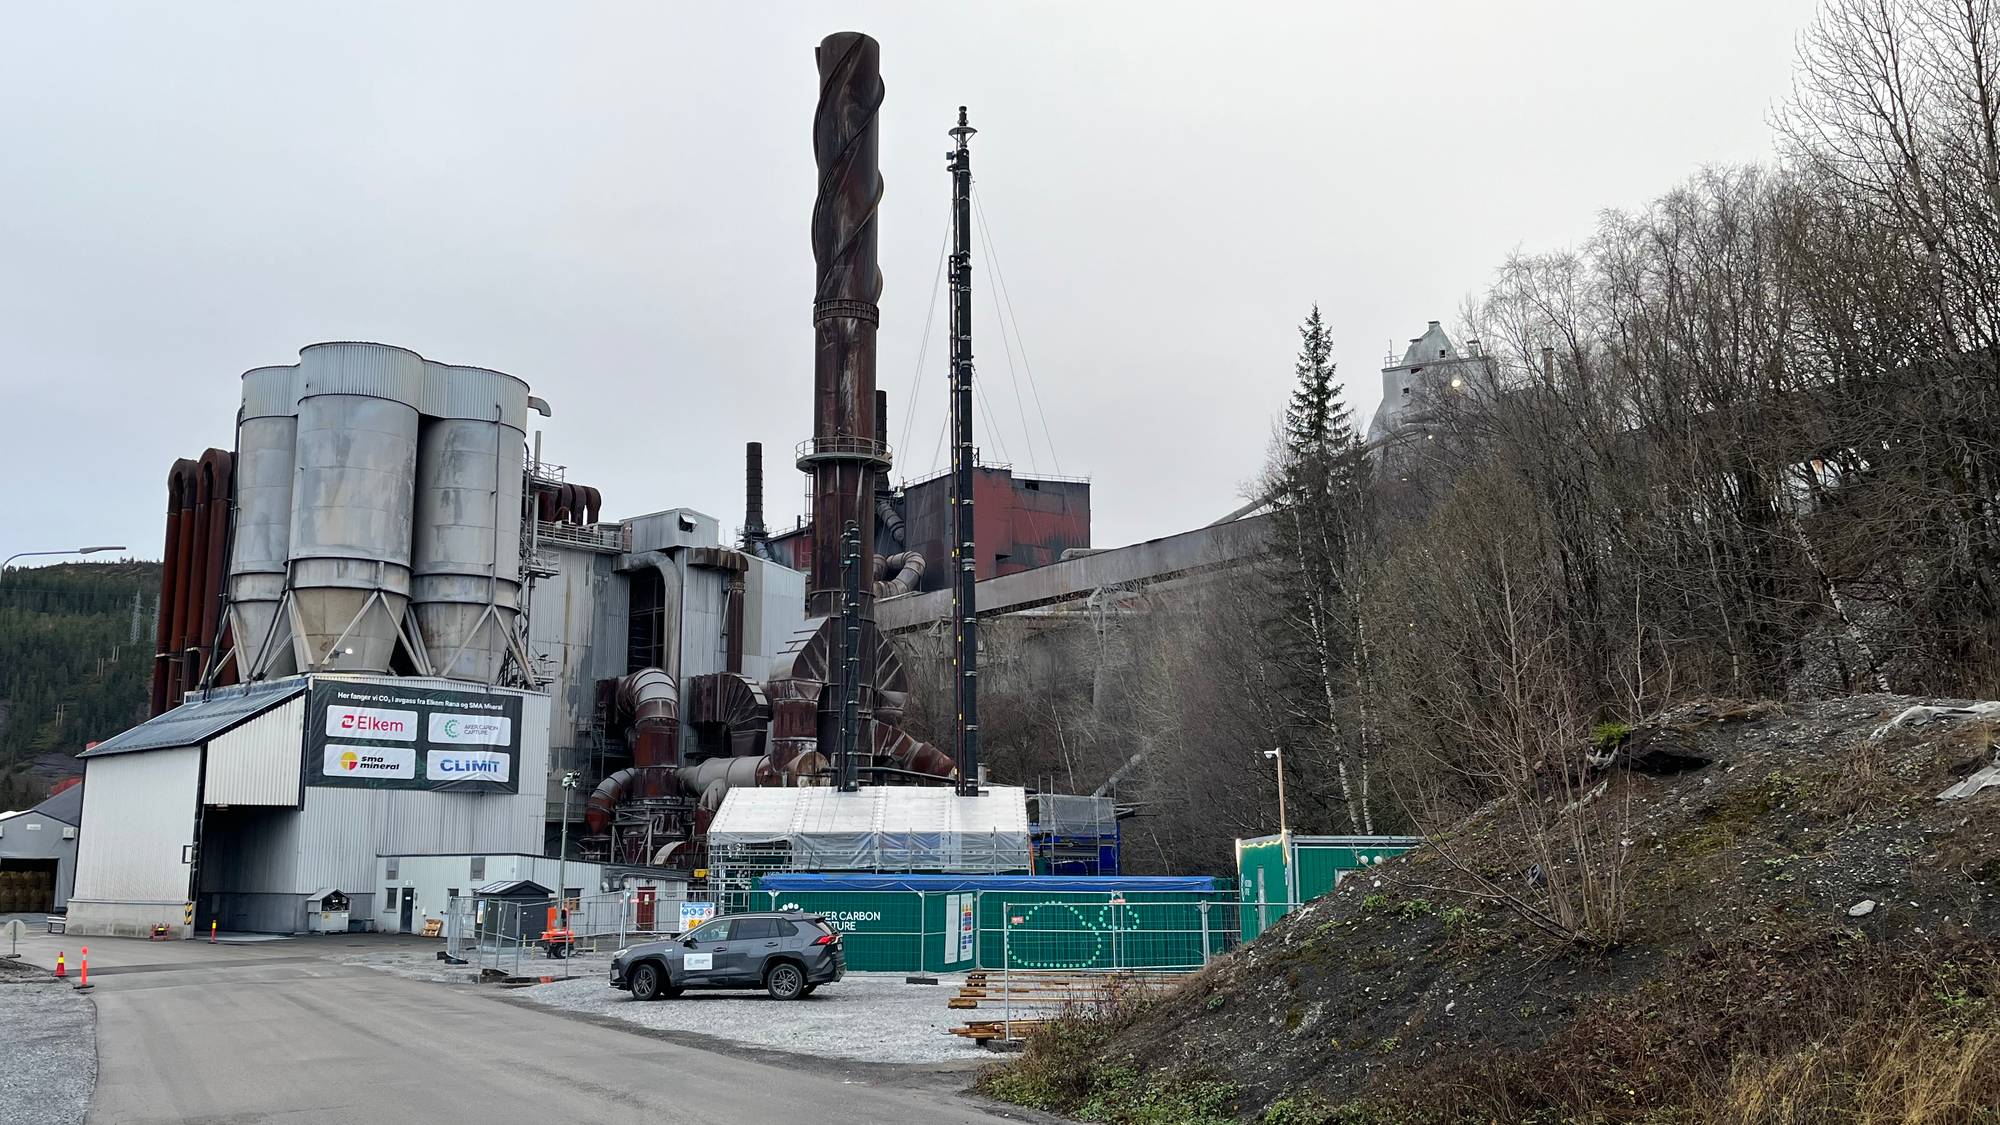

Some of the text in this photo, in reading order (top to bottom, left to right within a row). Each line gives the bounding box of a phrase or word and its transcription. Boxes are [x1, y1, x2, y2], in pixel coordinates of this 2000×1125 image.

[350, 693, 371, 702] fanger
[358, 716, 403, 732] Elkem
[360, 762, 399, 770] mineral
[440, 759, 500, 773] CLIMIT
[838, 911, 881, 921] CARBON
[826, 921, 857, 931] TURE
